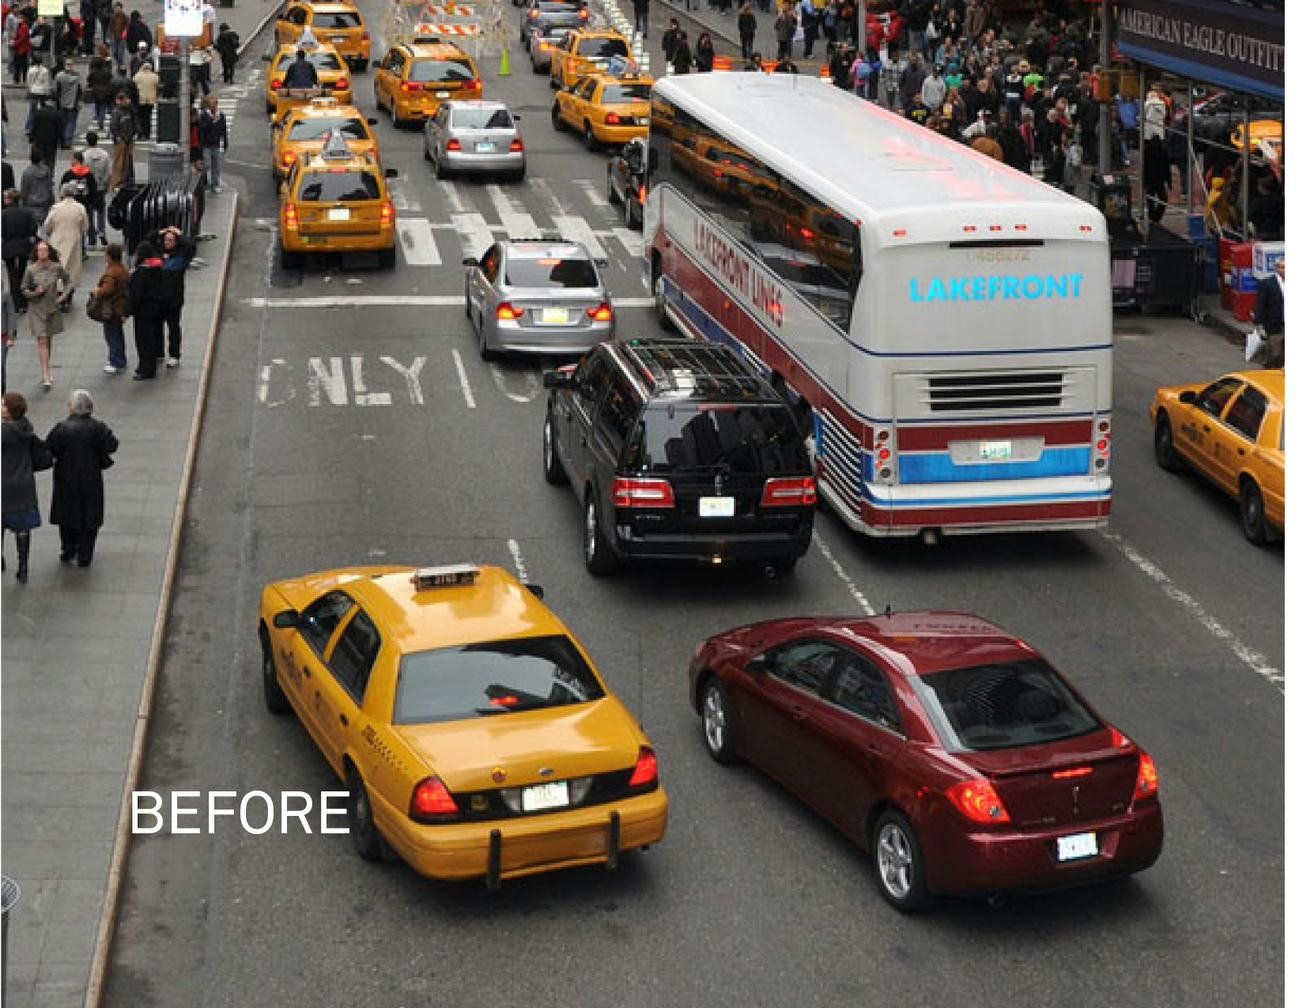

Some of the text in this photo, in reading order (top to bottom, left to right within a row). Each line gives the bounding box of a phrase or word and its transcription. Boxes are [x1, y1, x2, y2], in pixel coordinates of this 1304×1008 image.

[1120, 7, 1181, 43] AMERICAN
[1183, 21, 1226, 56] EAGLE
[694, 217, 784, 329] LAKEFRONT LINES
[909, 273, 1084, 303] LAKEFRONT
